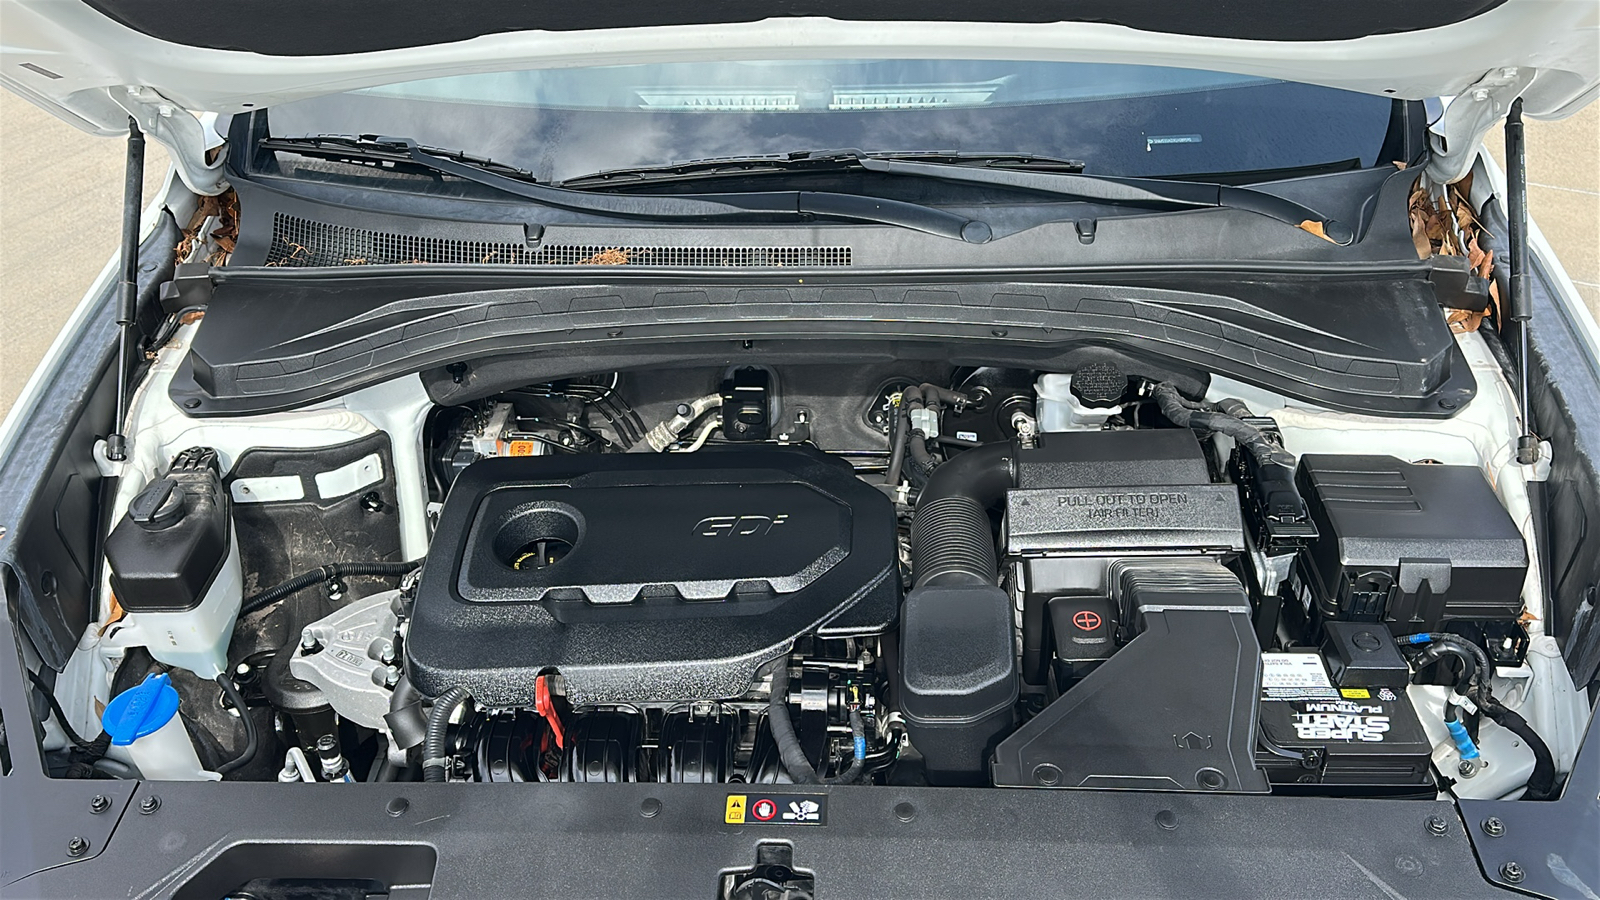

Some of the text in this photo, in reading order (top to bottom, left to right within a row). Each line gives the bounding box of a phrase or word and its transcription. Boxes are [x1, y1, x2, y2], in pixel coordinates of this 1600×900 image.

[1058, 492, 1188, 507] PULL OUT TO OPEN
[1306, 703, 1383, 714] PLATINUM
[1295, 714, 1391, 733] START
[1297, 727, 1384, 742] SUPER
